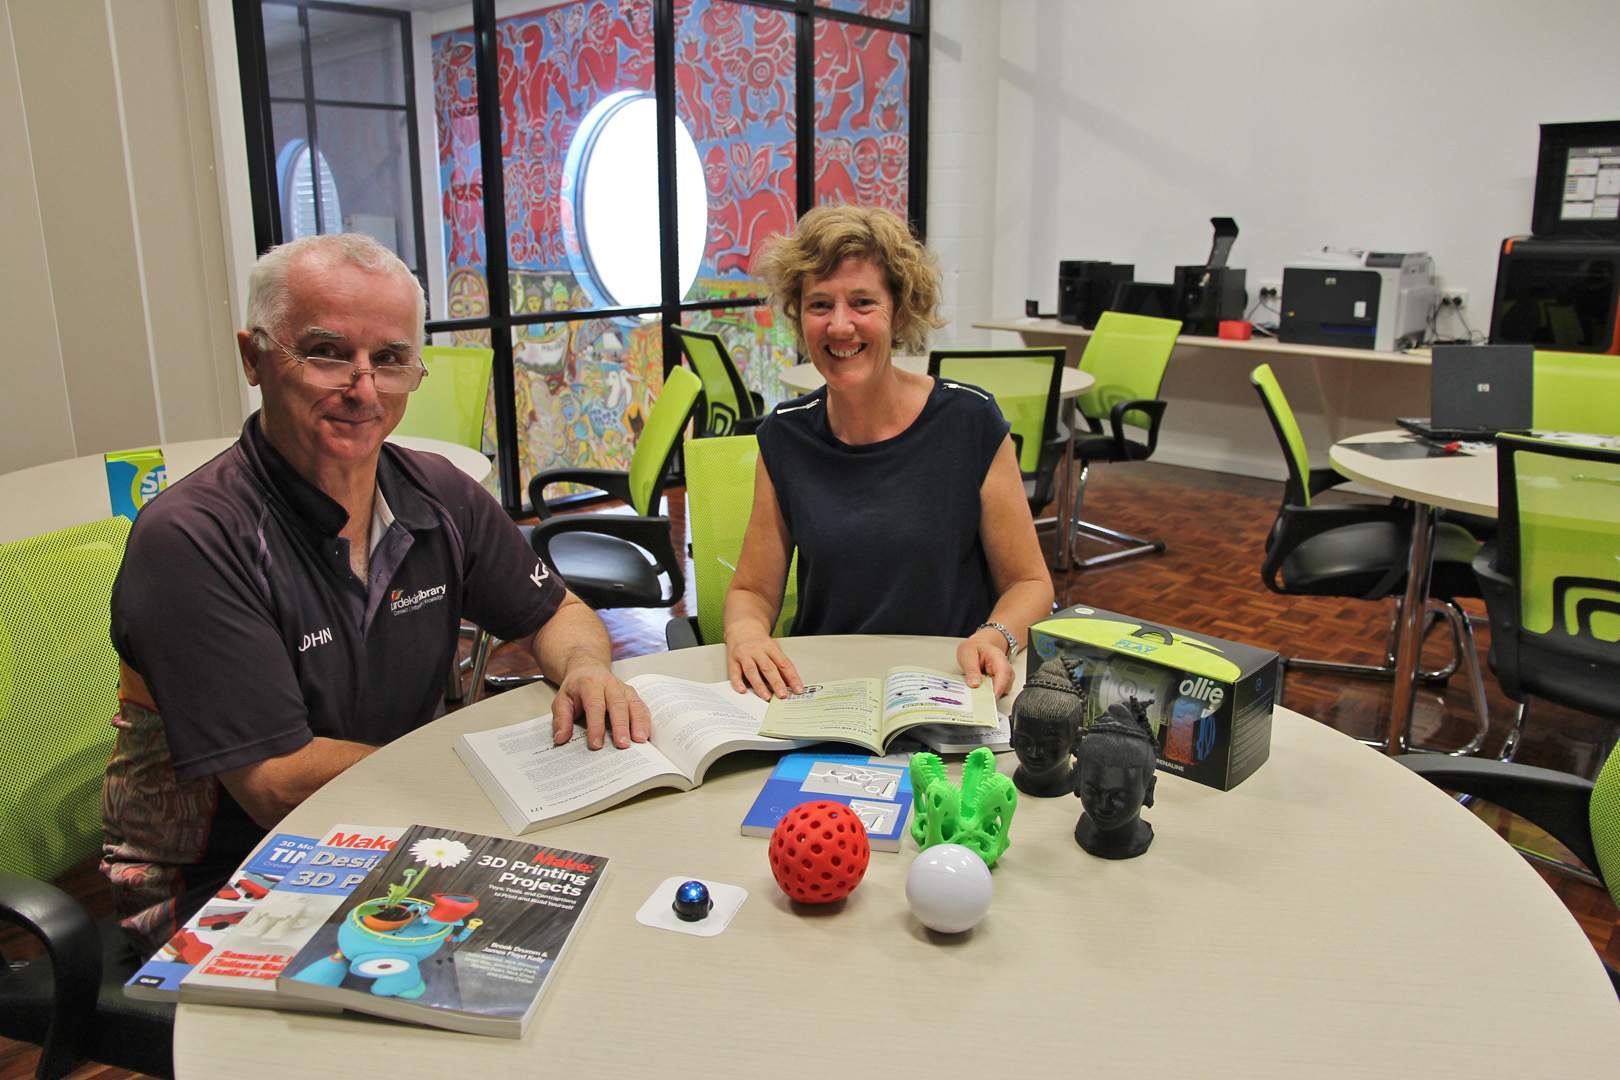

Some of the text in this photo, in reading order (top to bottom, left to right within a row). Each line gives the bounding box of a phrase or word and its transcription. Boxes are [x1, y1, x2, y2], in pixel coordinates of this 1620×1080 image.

[298, 627, 333, 652] JOHN
[1179, 677, 1224, 705] ollie
[478, 855, 591, 886] 3D Printing
[531, 851, 598, 874] Make:
[289, 871, 338, 888] 3D
[498, 872, 583, 897] Projects
